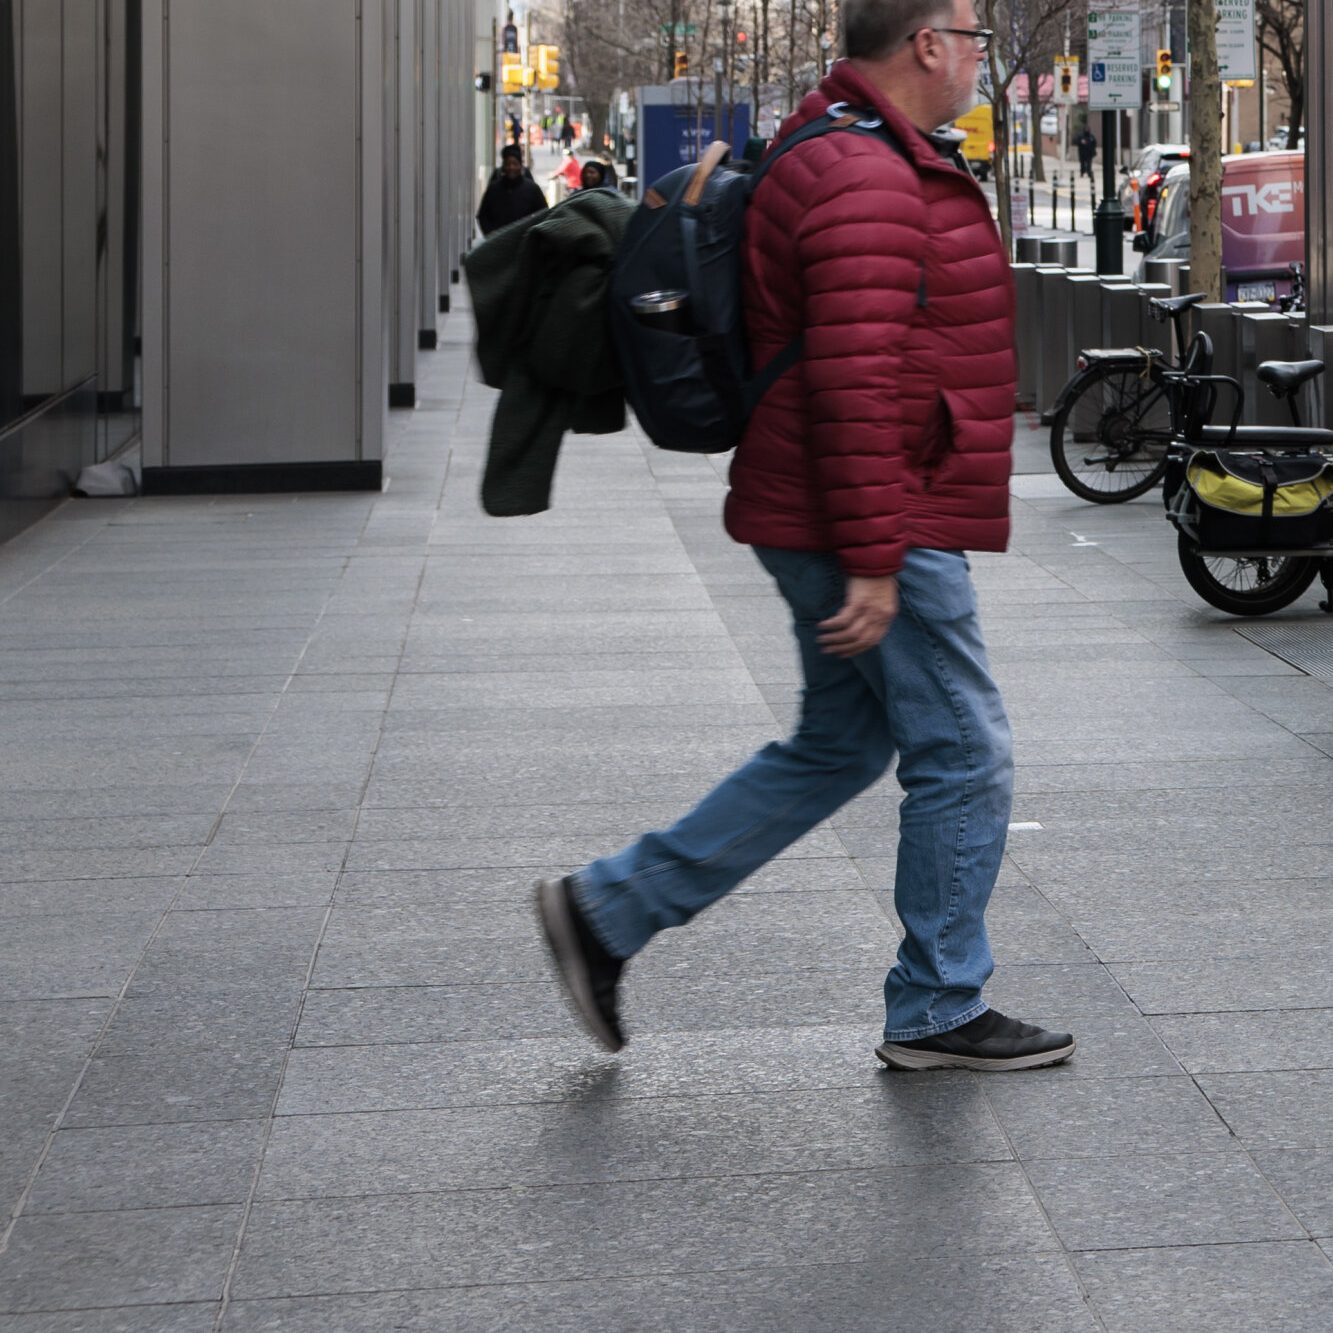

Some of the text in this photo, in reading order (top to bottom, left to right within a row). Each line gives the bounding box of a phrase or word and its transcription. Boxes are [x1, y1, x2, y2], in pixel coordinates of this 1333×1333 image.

[1218, 9, 1248, 20] ARKING
[1106, 62, 1138, 72] RESERVED
[1108, 74, 1136, 84] PARKING
[1221, 181, 1295, 217] TKE
